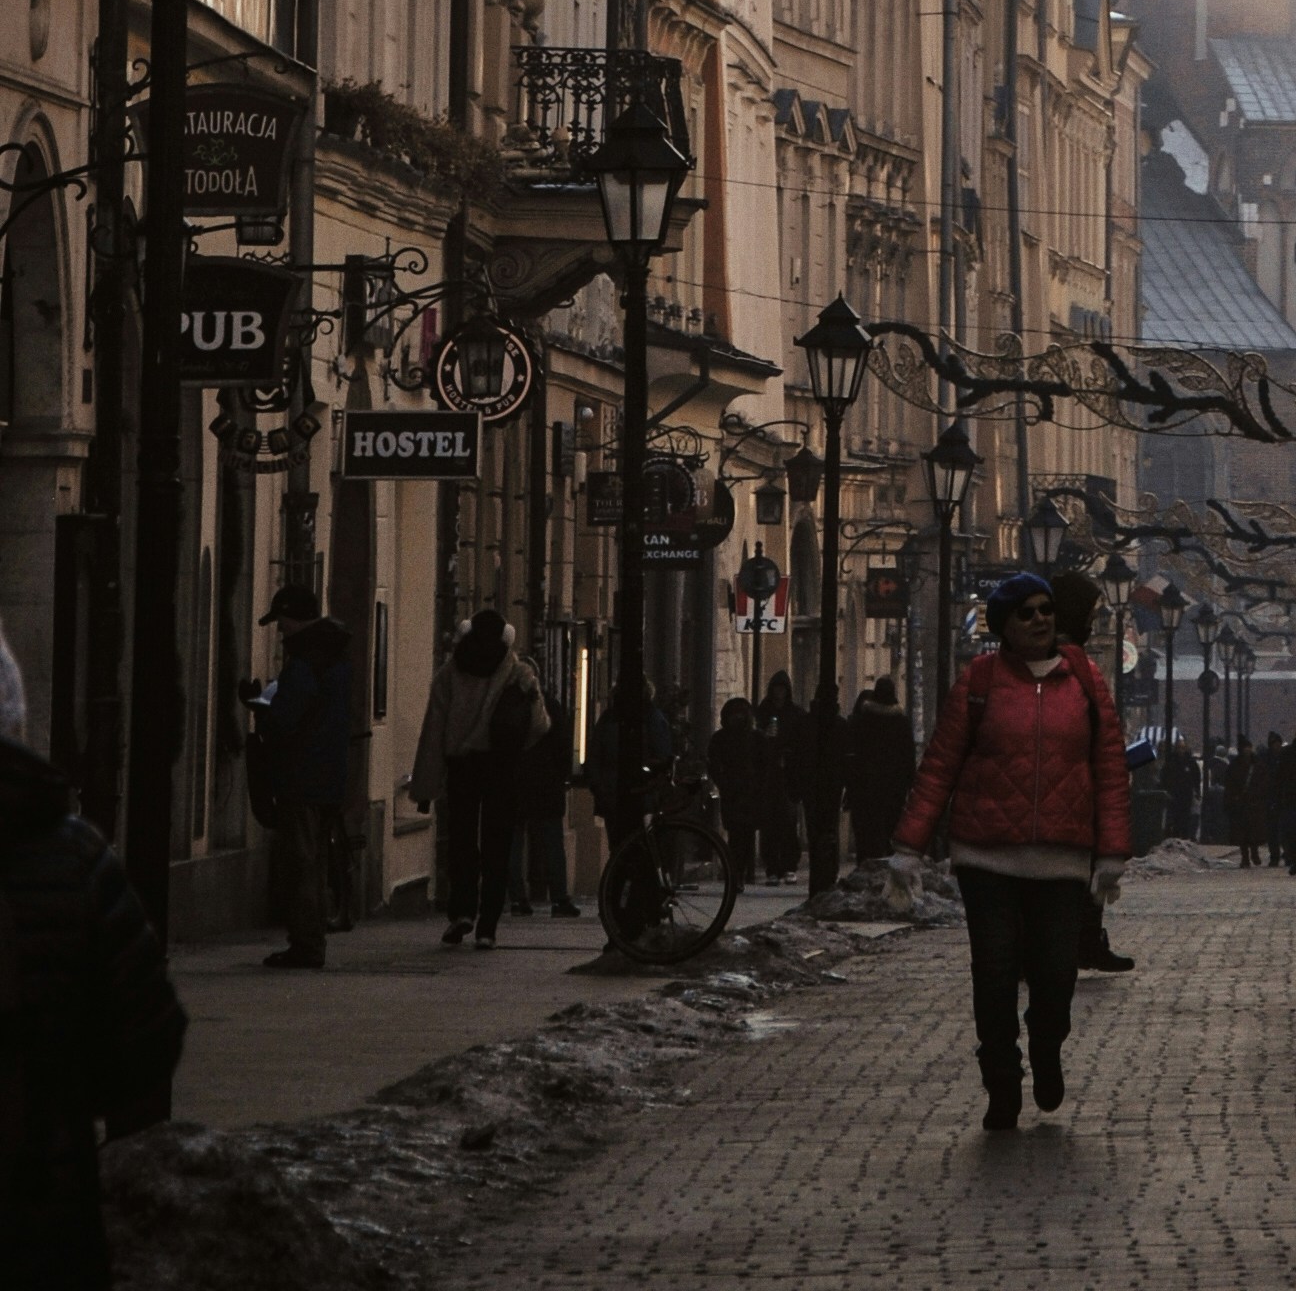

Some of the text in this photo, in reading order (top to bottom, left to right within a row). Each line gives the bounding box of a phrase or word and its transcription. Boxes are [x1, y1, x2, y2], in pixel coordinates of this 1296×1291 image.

[185, 111, 276, 140] TAURACJA
[184, 165, 258, 197] TODOŁA
[496, 393, 516, 411] PUB
[353, 431, 470, 458] HOSTEL
